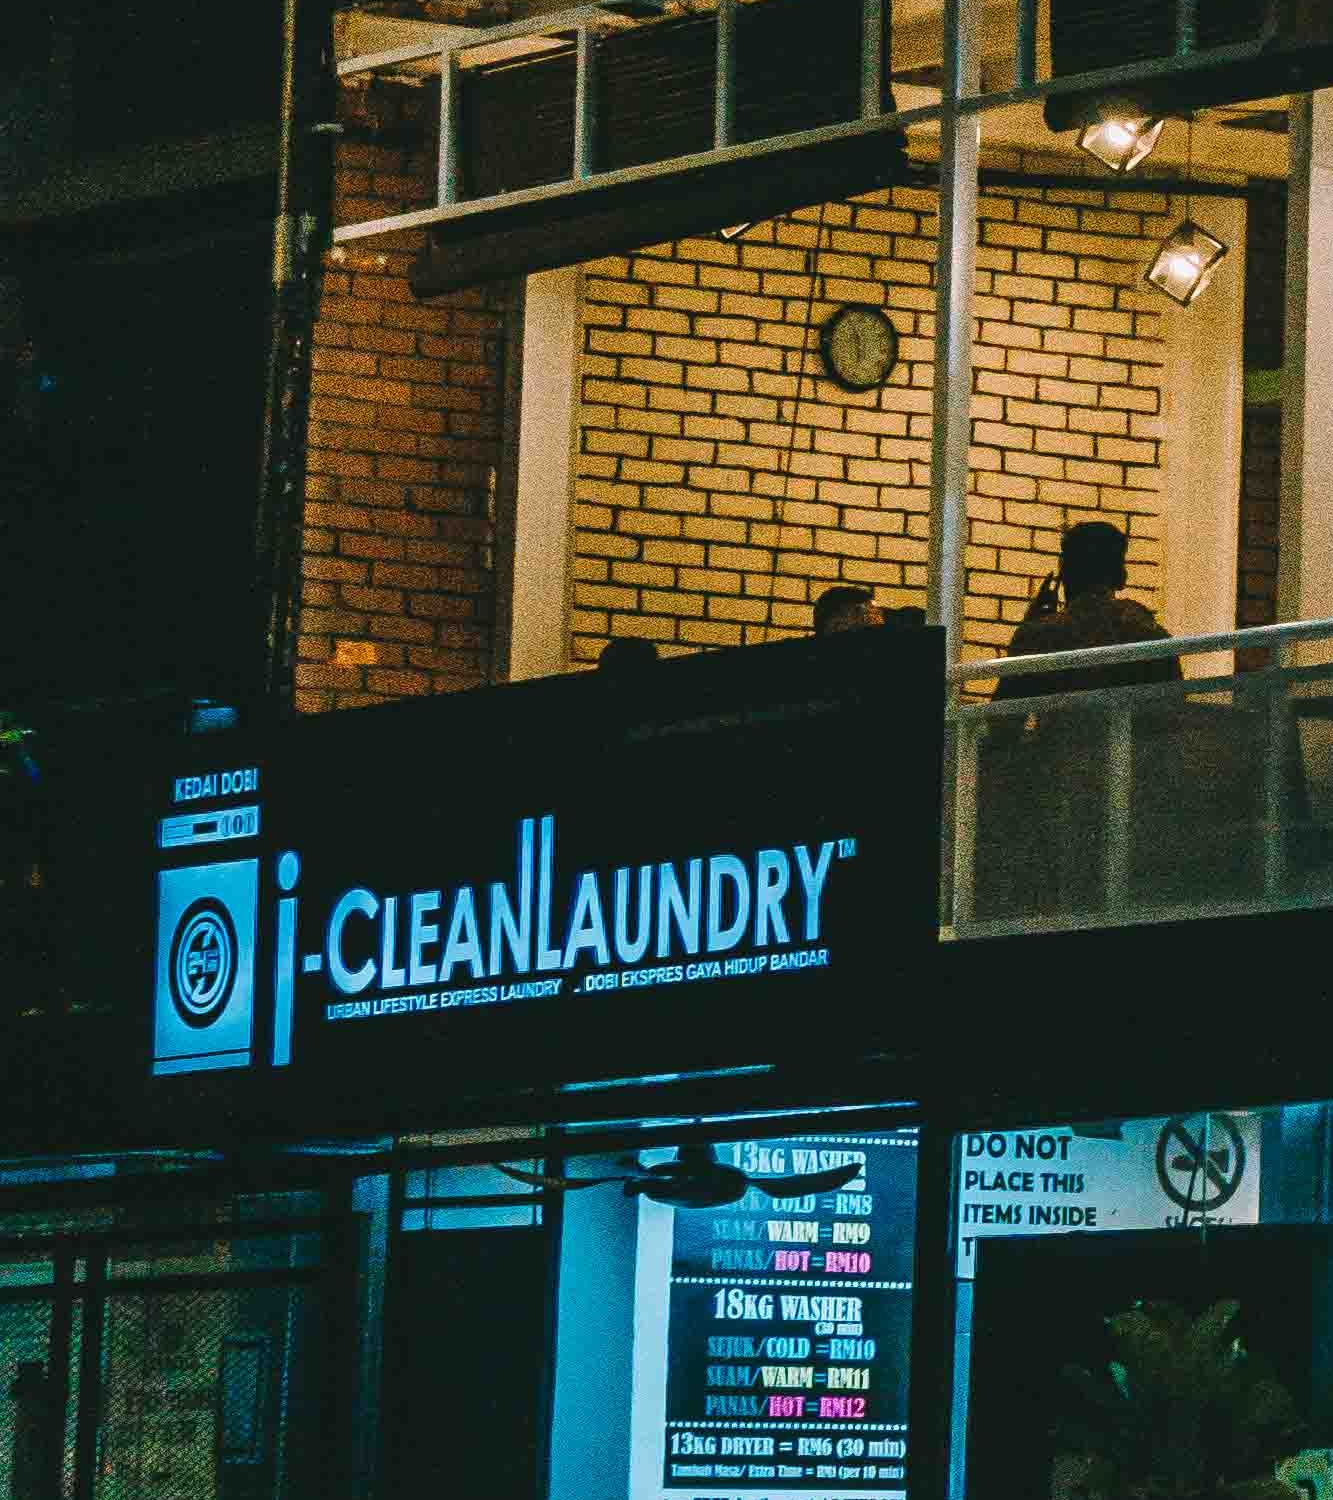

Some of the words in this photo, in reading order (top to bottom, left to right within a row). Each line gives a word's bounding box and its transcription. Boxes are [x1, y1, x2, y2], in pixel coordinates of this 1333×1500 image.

[174, 773, 217, 802] KEDAI
[221, 767, 258, 795] DOBI
[327, 1001, 370, 1020] URBAN
[373, 992, 438, 1016] LIFESTYLE
[440, 986, 498, 1009] EXPRESS
[500, 977, 562, 1001] LAUNDRY
[585, 972, 619, 992] DOBI
[621, 965, 683, 989] EKSPRES
[685, 960, 721, 980] GAYA
[724, 955, 767, 976] HIDUP
[770, 948, 828, 970] BANDAR
[965, 1133, 1007, 1159] DO
[1015, 1133, 1072, 1161] NOT
[964, 1170, 1034, 1193] PLACE
[1042, 1172, 1085, 1194] THIS
[963, 1203, 1022, 1225] ITEMS
[1029, 1205, 1097, 1227] INSIDE
[714, 1287, 774, 1320] 18KG
[780, 1295, 862, 1322] WASHER
[670, 1431, 717, 1456] 13KG
[720, 1436, 774, 1456] DRYER
[778, 1441, 794, 1452] =
[797, 1437, 833, 1457] RM6
[836, 1438, 865, 1459] (30
[868, 1438, 907, 1459] min)
